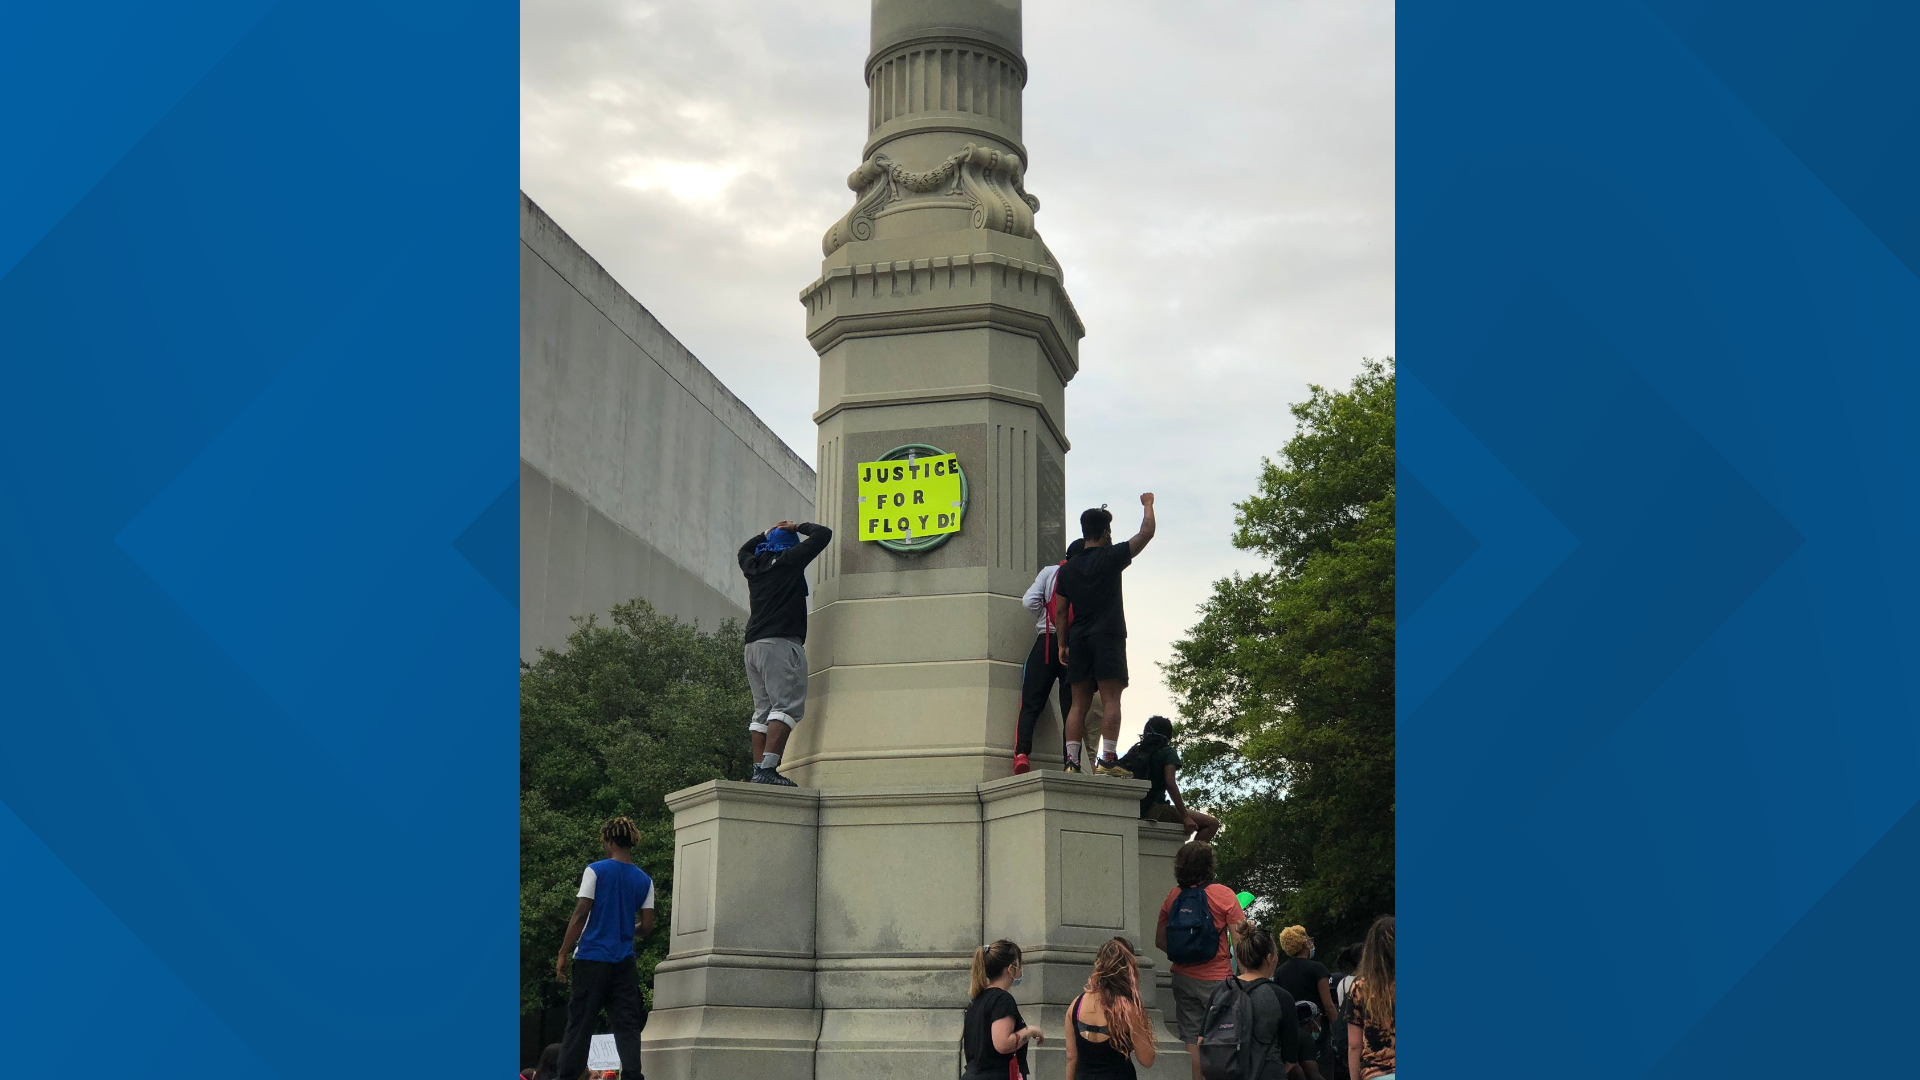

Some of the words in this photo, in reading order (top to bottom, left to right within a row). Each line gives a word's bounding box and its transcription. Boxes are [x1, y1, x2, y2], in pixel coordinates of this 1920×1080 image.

[863, 458, 959, 483] JUSTICE
[877, 489, 925, 509] FOR
[869, 512, 956, 534] FLOYD!
